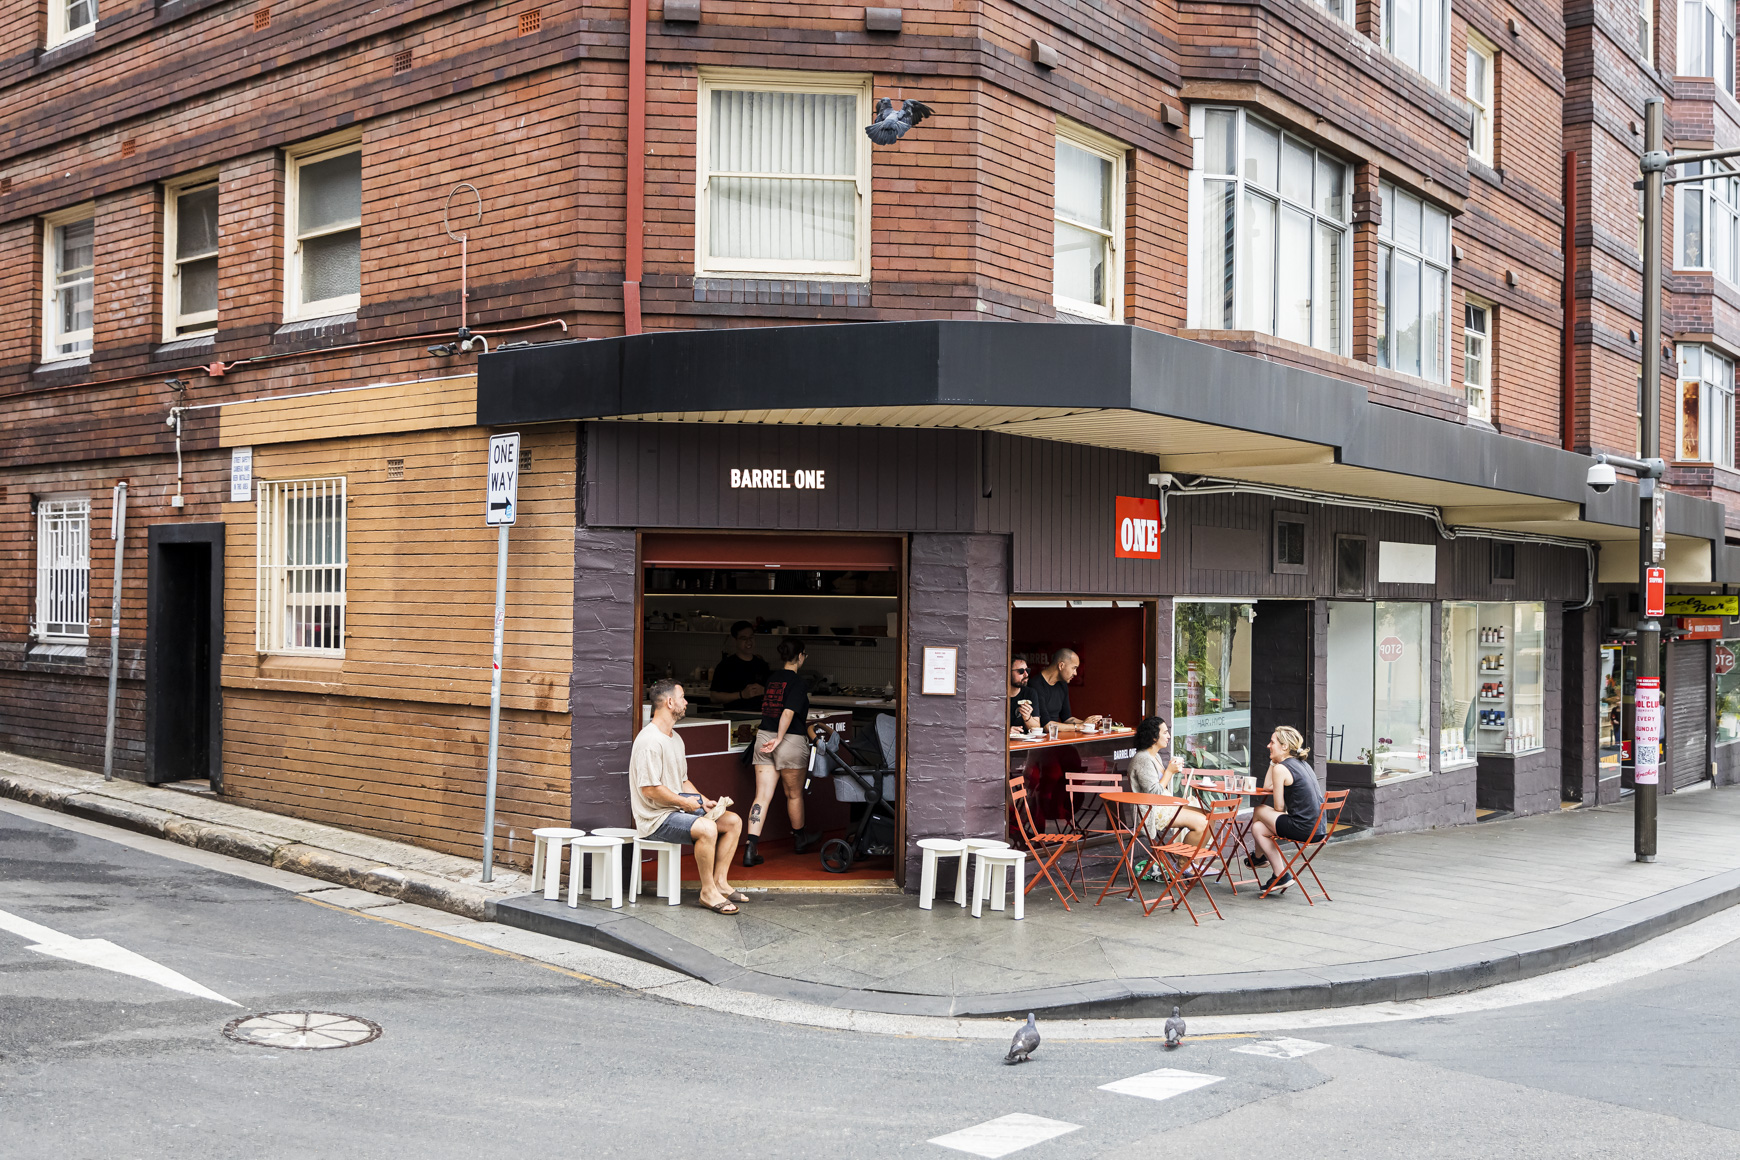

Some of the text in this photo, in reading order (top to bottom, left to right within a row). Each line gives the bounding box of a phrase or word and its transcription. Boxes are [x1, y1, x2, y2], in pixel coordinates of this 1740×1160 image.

[493, 442, 514, 464] ONE
[491, 471, 514, 492] WAY
[730, 468, 825, 489] BARREL ONE
[1121, 517, 1158, 553] ONE
[1692, 602, 1725, 613] Bar
[1646, 700, 1660, 709] CLU
[836, 722, 846, 732] ONE
[1113, 749, 1129, 760] BARREL
